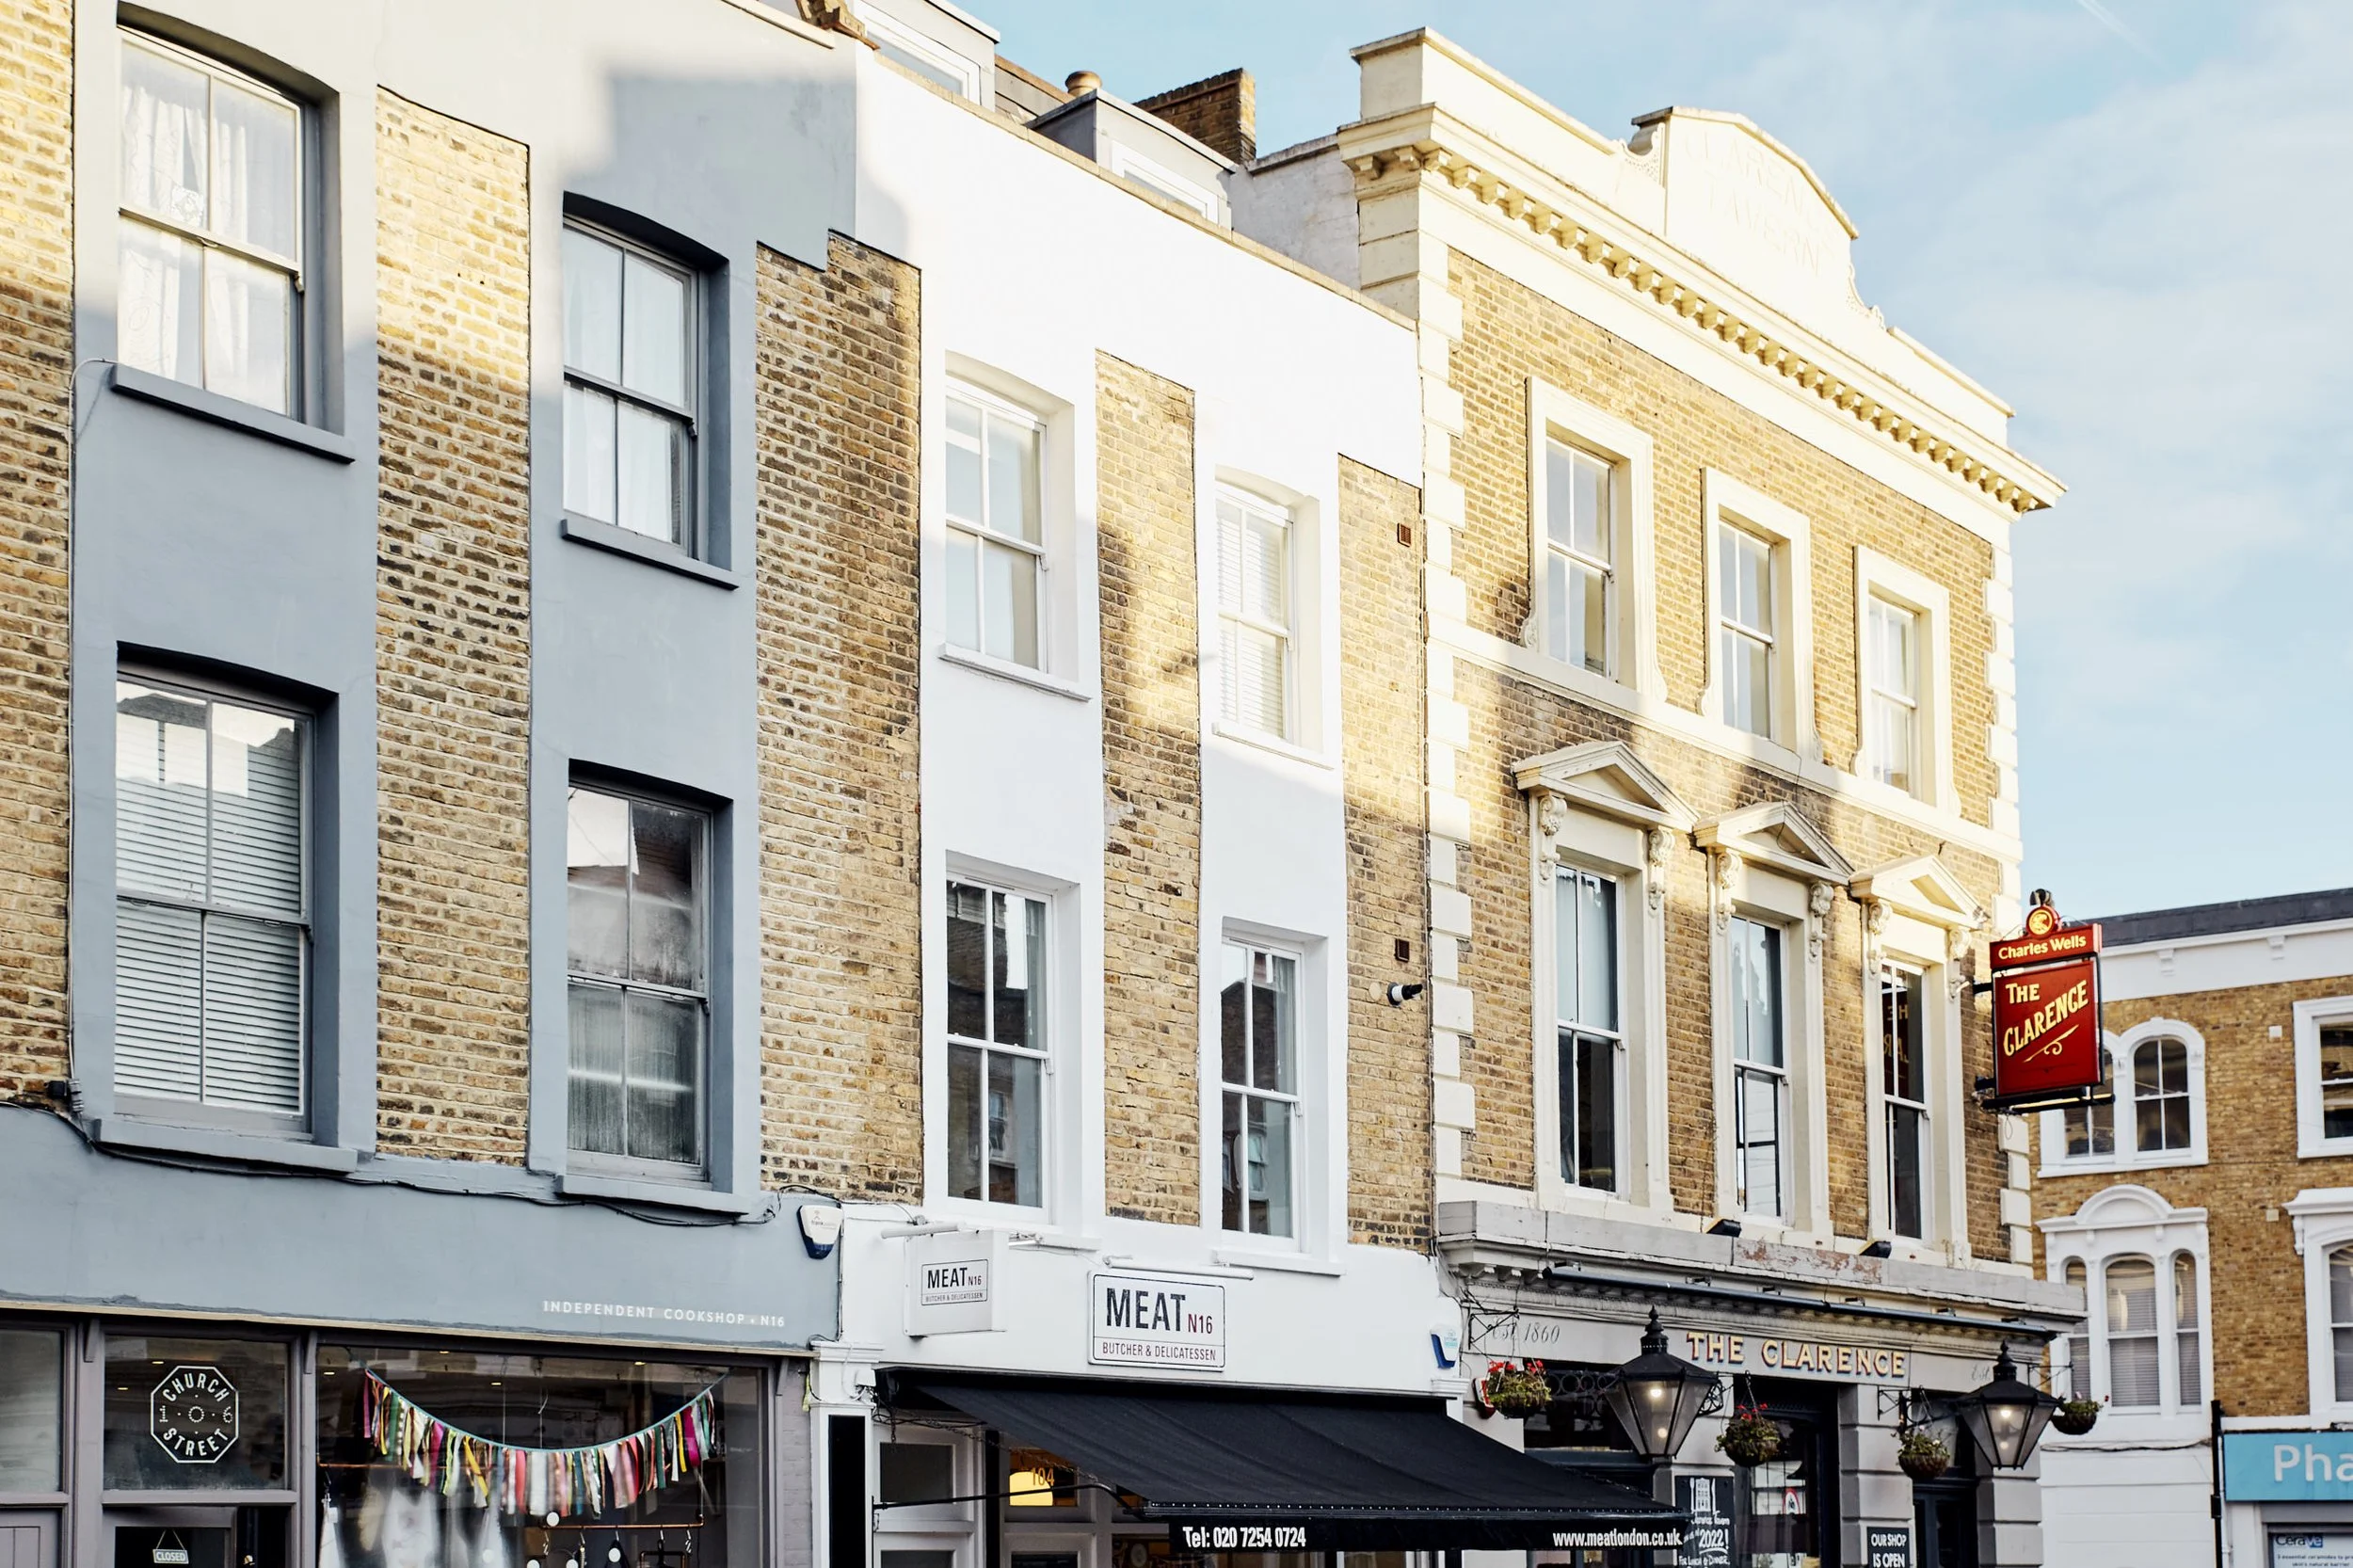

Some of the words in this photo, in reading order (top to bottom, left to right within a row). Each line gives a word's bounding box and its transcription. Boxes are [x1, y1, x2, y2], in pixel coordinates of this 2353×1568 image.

[1998, 942, 2048, 960] Charles
[2050, 935, 2087, 952] Wells
[2005, 983, 2041, 1004] THE
[2003, 980, 2089, 1057] CLARENCE
[927, 1267, 968, 1288] MEAT
[968, 1275, 982, 1286] N16
[925, 1294, 946, 1303] BUTCHER
[951, 1292, 983, 1301] DELICATESSEN
[543, 1300, 656, 1319] INDEPENDENT
[664, 1308, 744, 1324] COOKSHOP
[760, 1315, 785, 1327] N16
[1106, 1288, 1186, 1332] MEAT
[1188, 1313, 1213, 1335] N16
[1523, 1321, 1561, 1344] 1860
[1102, 1342, 1143, 1356] BUTCHER
[1145, 1345, 1151, 1356] &
[1155, 1345, 1216, 1361] DELICATESSEN
[1687, 1331, 1745, 1364] THE
[1761, 1339, 1907, 1378] CLARENCE
[162, 1372, 230, 1402] CHURCH
[163, 1428, 228, 1457] STREET
[2274, 1444, 2353, 1481] Pha
[1032, 1467, 1054, 1486] 104
[1182, 1527, 1210, 1548] Tel:
[1213, 1527, 1238, 1548] 020
[1240, 1527, 1273, 1548] 7254
[1274, 1527, 1307, 1548] 0724
[1553, 1528, 1683, 1546] www.meatlondon.co.uk
[1871, 1533, 1887, 1546] OUR
[1887, 1533, 1907, 1546] SHOP
[2276, 1534, 2322, 1548] CeraVe
[156, 1551, 186, 1561] CLOSED
[1873, 1553, 1881, 1568] IS
[1882, 1553, 1905, 1568] OPEN
